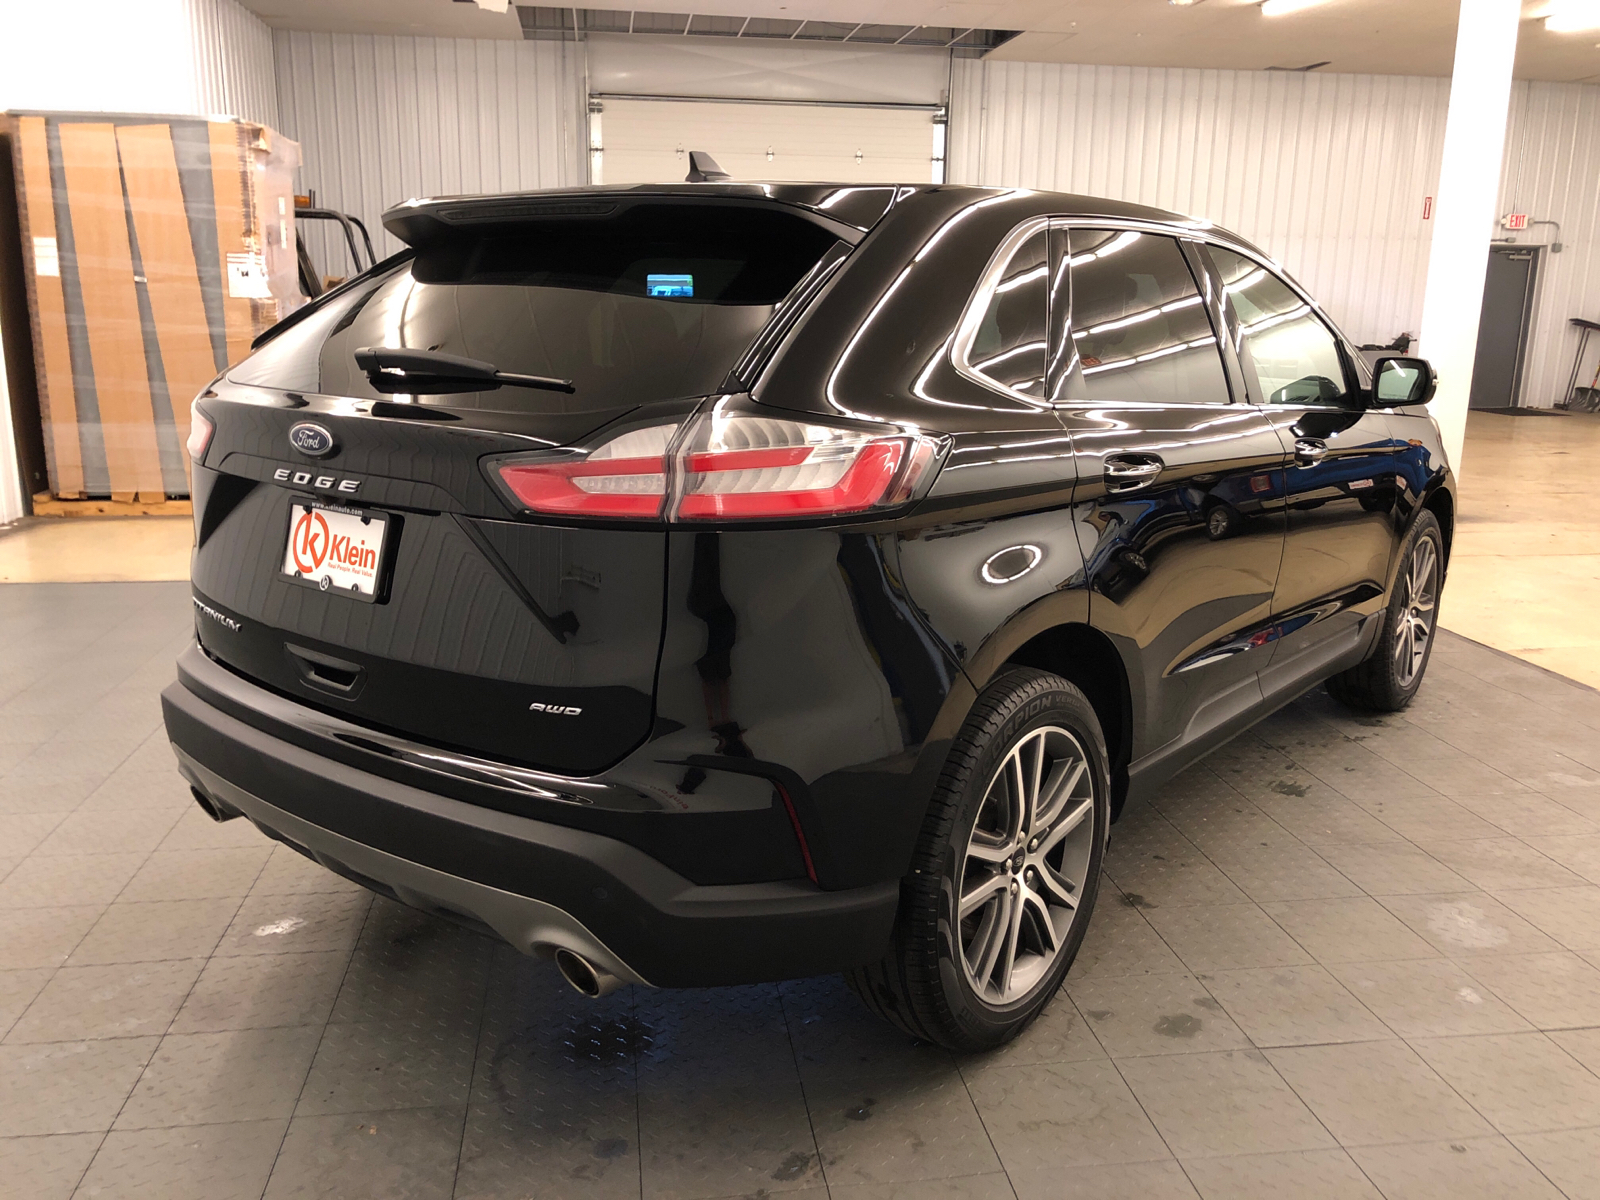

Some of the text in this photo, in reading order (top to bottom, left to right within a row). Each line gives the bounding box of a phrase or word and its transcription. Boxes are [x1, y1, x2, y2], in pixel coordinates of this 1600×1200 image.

[1509, 214, 1526, 228] EXIT
[297, 429, 320, 449] Ford
[273, 468, 361, 493] EDGE
[329, 534, 376, 570] Klein
[529, 702, 583, 716] AWD
